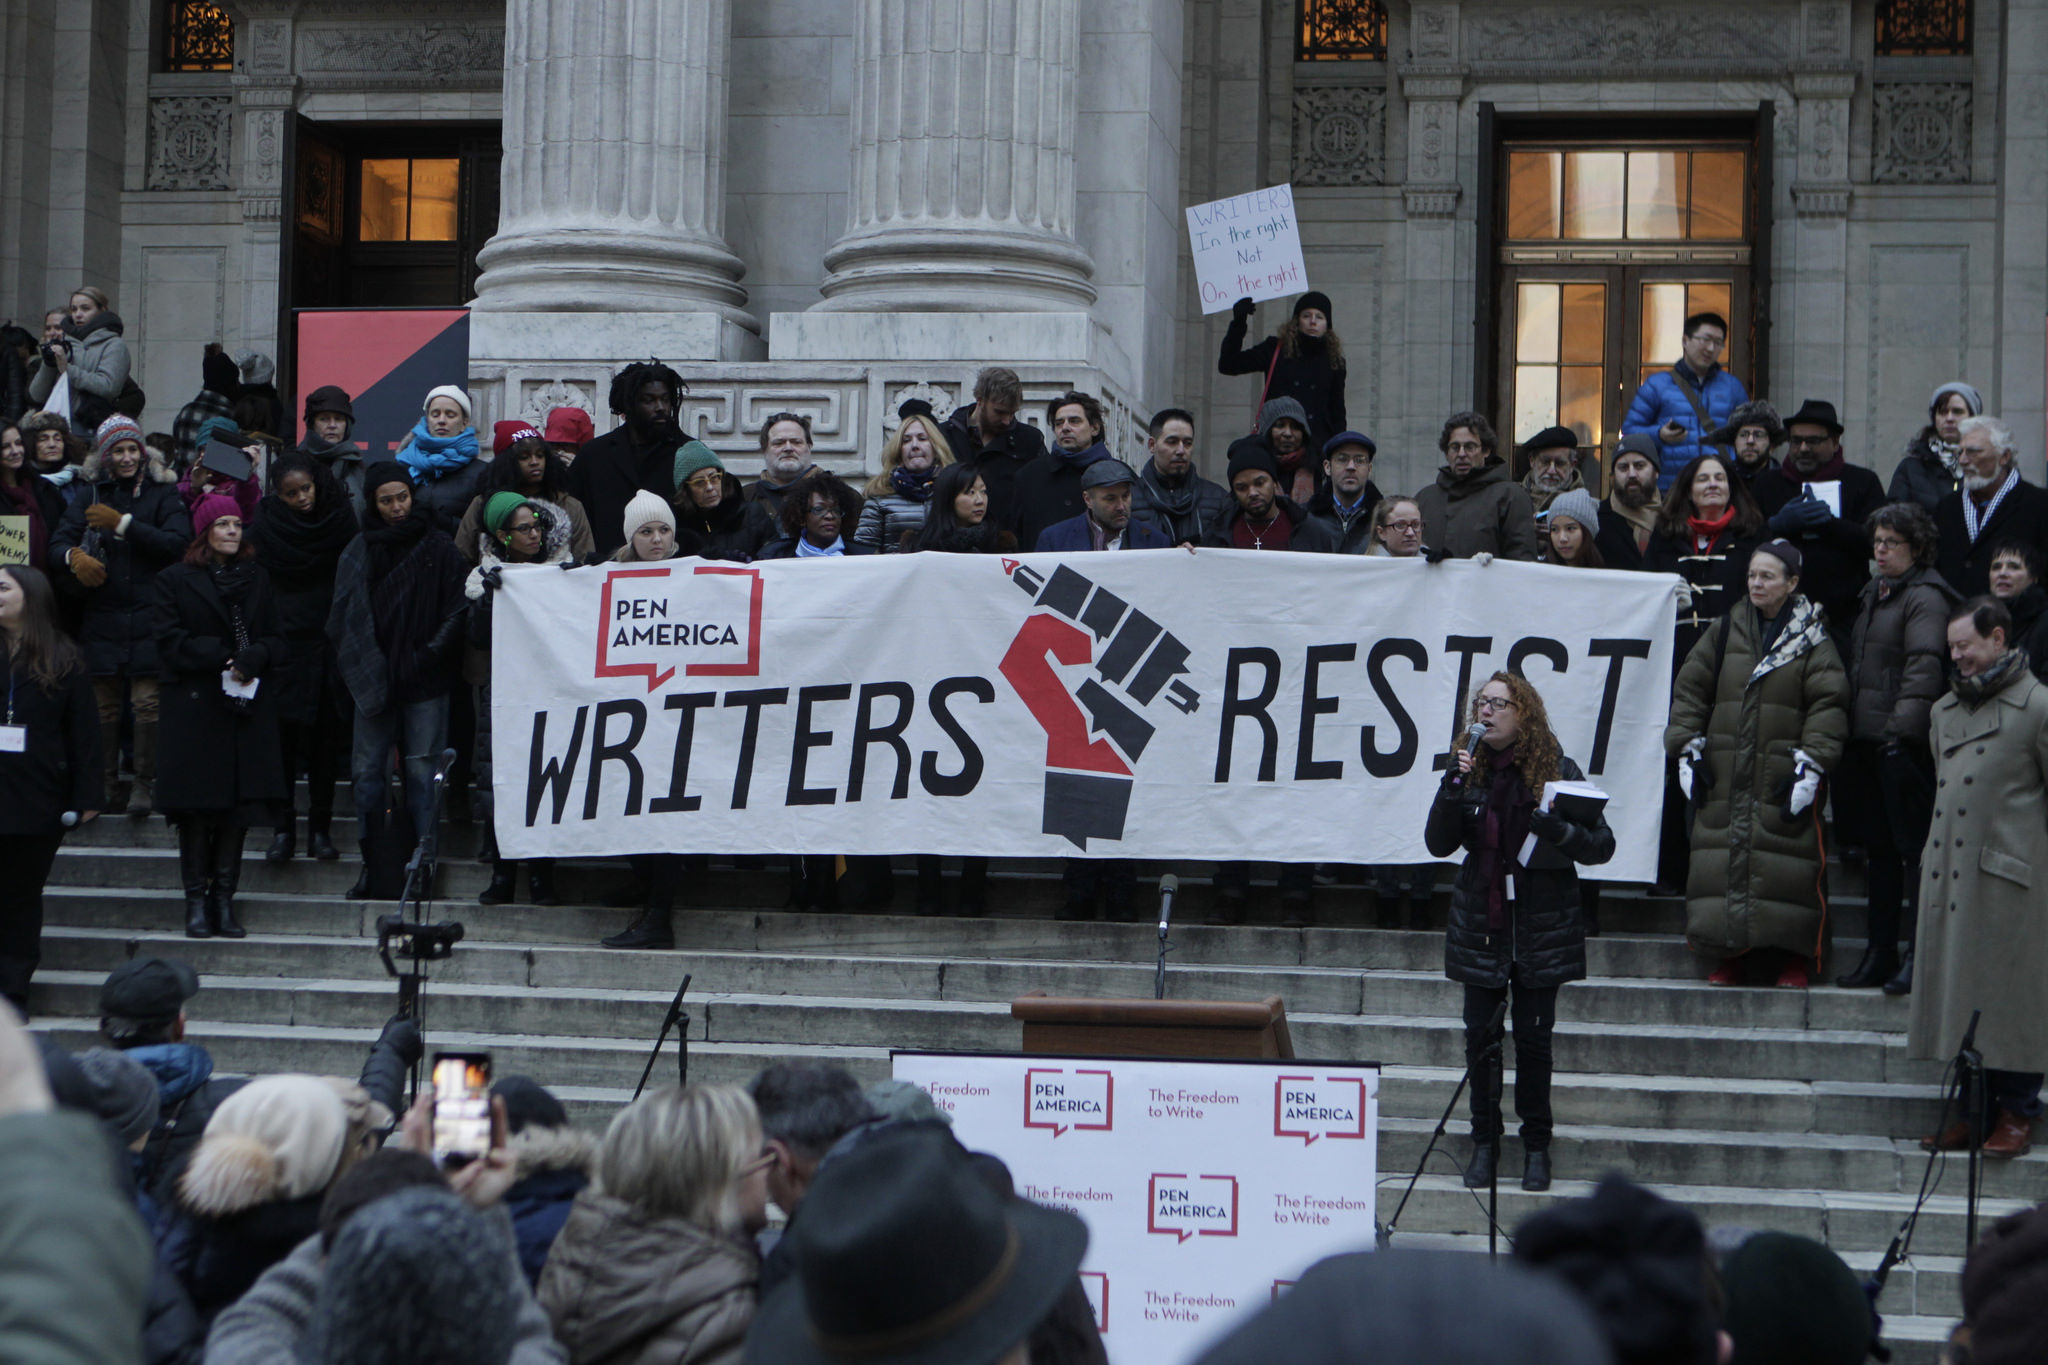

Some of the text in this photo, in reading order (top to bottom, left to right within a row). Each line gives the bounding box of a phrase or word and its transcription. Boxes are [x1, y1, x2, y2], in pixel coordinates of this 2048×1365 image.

[1192, 185, 1291, 227] WRITERS
[1195, 213, 1289, 253] In the right
[1236, 245, 1263, 265] Not
[1202, 261, 1298, 304] On the right
[511, 429, 538, 442] NYC
[616, 598, 669, 621] PEN
[612, 623, 740, 648] AMERICA
[525, 676, 996, 828] WRITERS
[930, 1081, 990, 1097] Freedom
[1034, 1084, 1065, 1097] PEN
[1148, 1088, 1240, 1104] The Freedom
[1285, 1091, 1316, 1104] PEN
[1034, 1099, 1102, 1113] AMERICA
[1148, 1105, 1204, 1120] to Write
[1285, 1107, 1354, 1121] AMERICA
[1024, 1184, 1113, 1202] The Freedom
[1159, 1189, 1189, 1201] PEN
[1274, 1193, 1366, 1211] The Freedom
[1159, 1205, 1227, 1219] AMERICA
[1274, 1210, 1330, 1226] to Write
[1144, 1290, 1236, 1309] The Freedom
[1144, 1307, 1200, 1323] to Write
